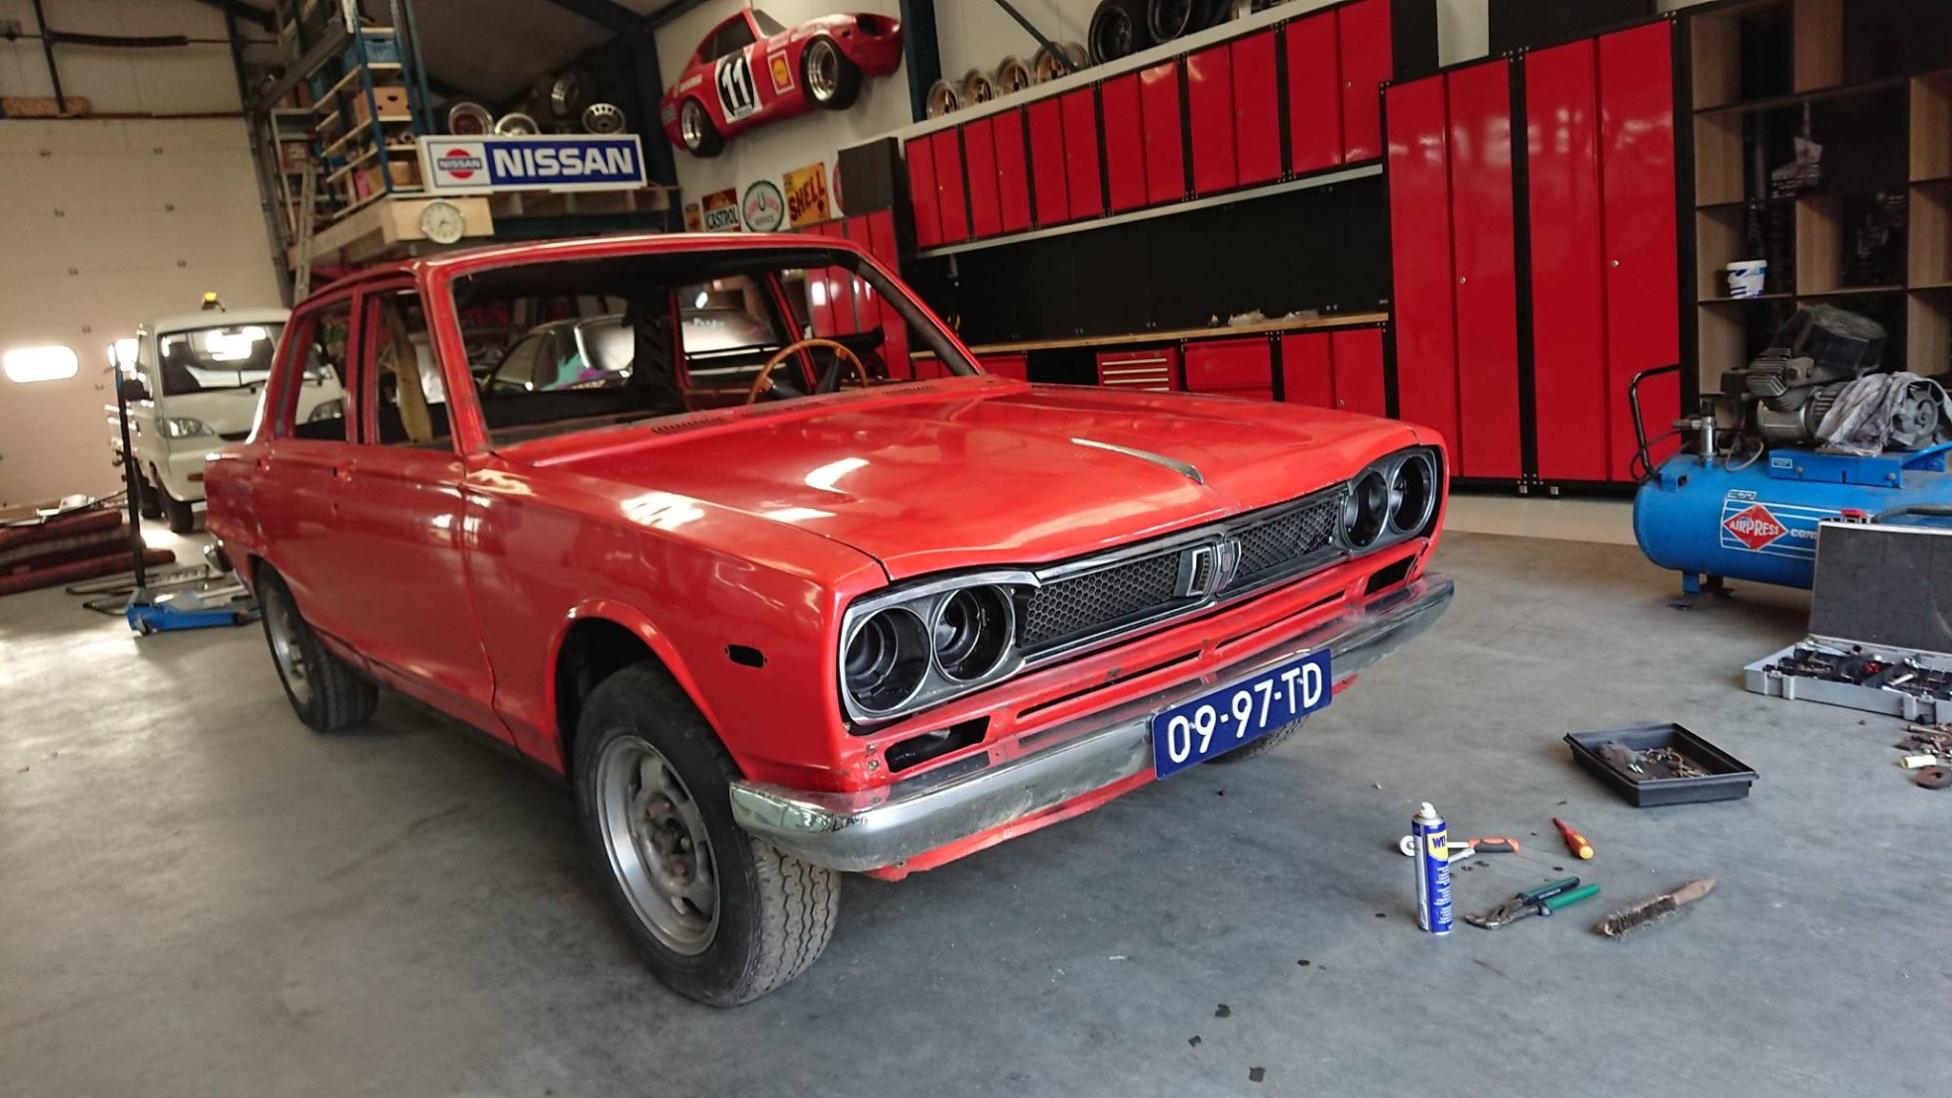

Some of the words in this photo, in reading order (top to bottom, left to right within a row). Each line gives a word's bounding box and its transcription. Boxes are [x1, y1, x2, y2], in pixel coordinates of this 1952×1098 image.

[721, 57, 751, 110] 11
[492, 148, 634, 177] NISSAN
[788, 170, 825, 221] SHELL
[705, 206, 738, 229] CASTROL
[1729, 516, 1780, 537] AIRPRESS
[1167, 662, 1322, 763] 09-97-TD
